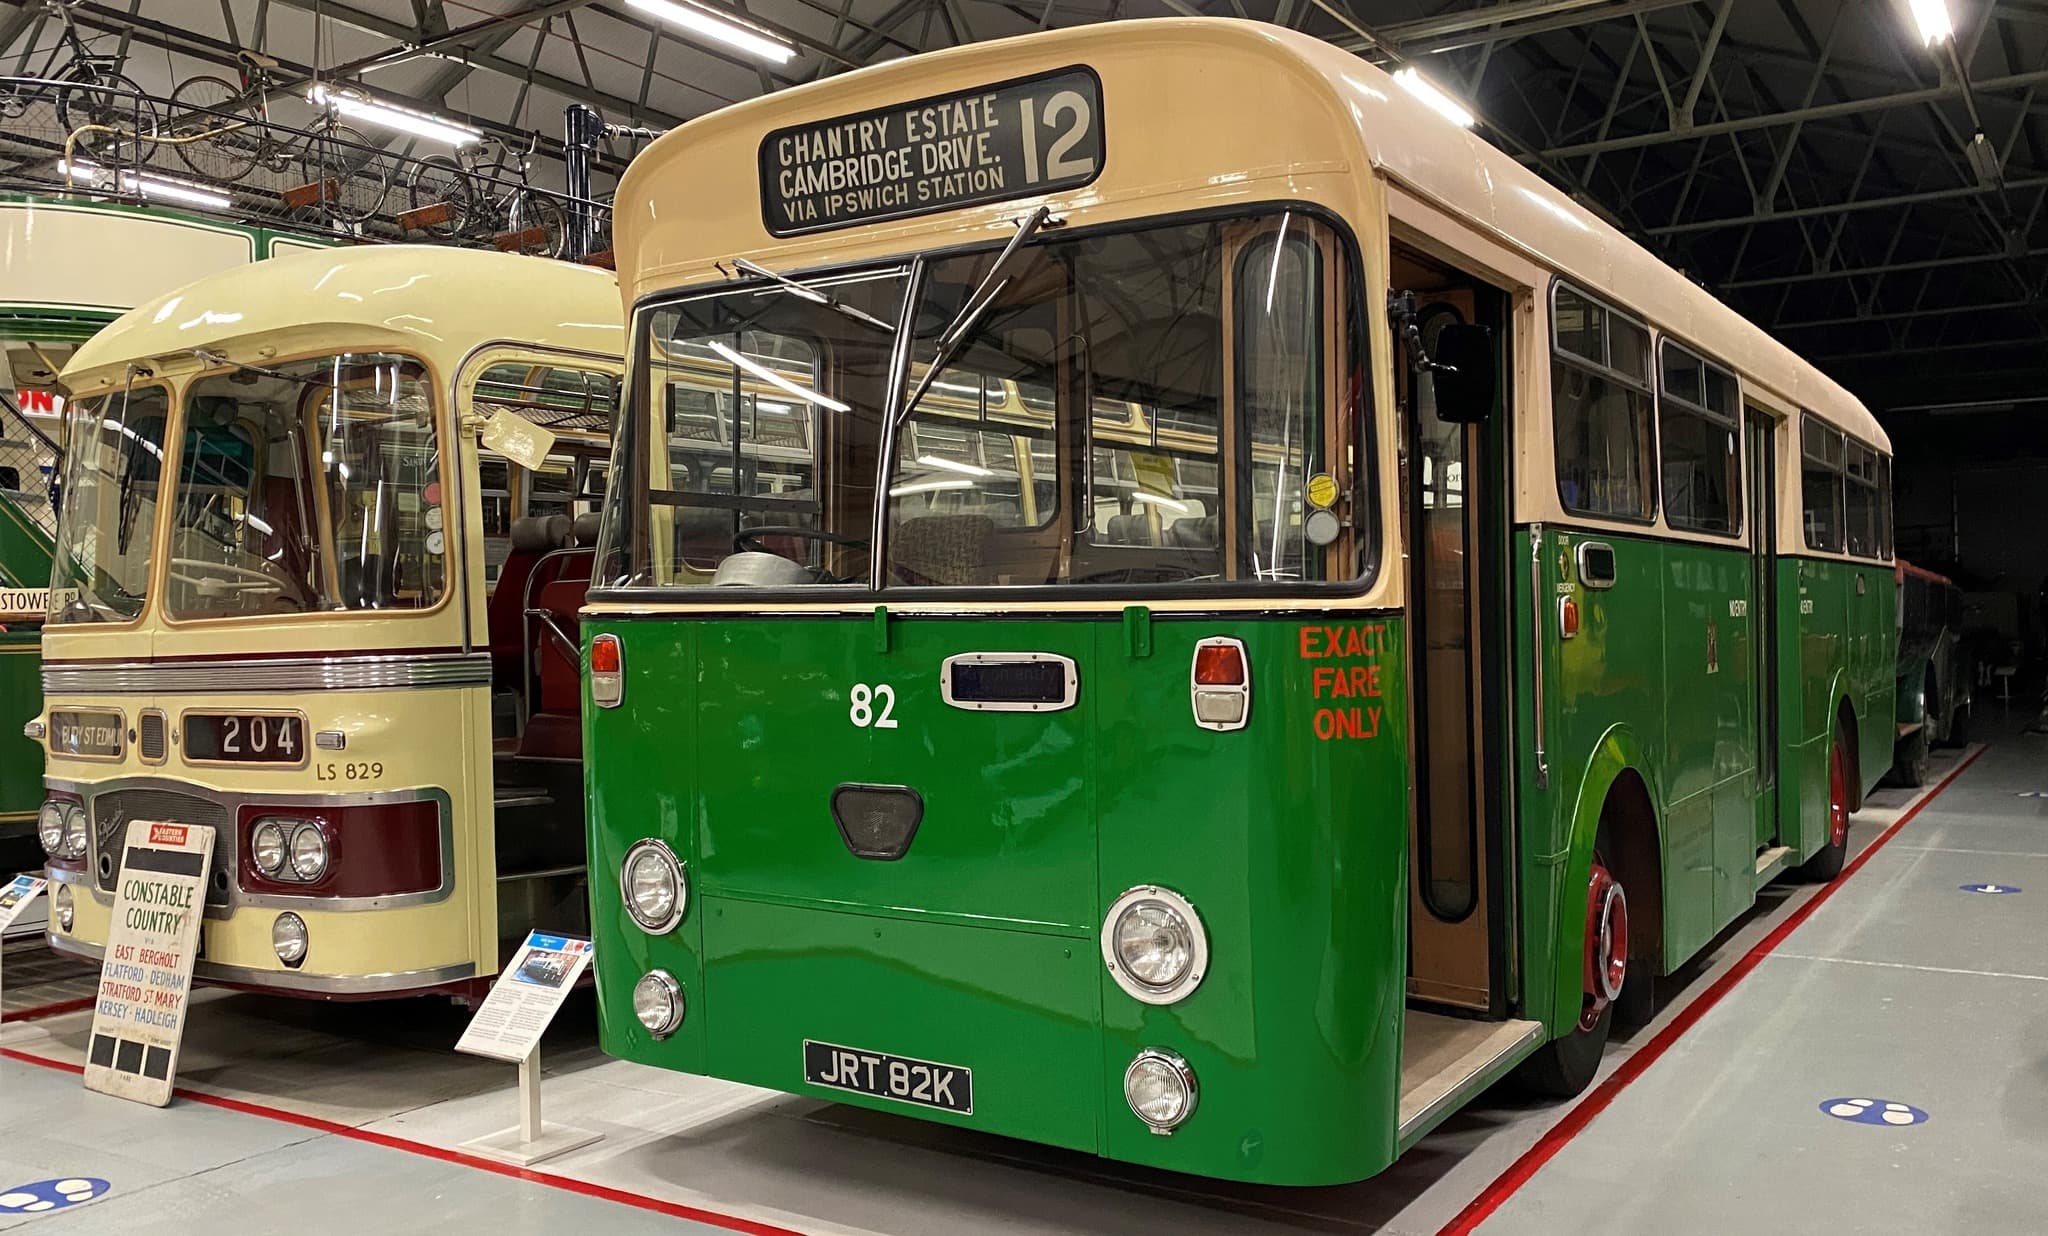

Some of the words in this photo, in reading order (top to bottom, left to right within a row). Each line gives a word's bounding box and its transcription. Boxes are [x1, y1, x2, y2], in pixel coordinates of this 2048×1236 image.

[778, 117, 889, 166] CHANTRY
[906, 94, 999, 142] ESTATE
[1019, 90, 1094, 184] 12
[780, 147, 914, 198] CAMBRIDGE
[922, 132, 1001, 173] DRIVE.
[783, 197, 817, 223] VIA
[825, 182, 909, 217] IPSWICH
[917, 166, 1004, 200] STATION
[1300, 624, 1385, 658] EXACT
[1313, 665, 1381, 699] FARE
[850, 683, 898, 728] 82
[223, 716, 294, 754] 204
[1313, 706, 1381, 740] ONLY
[317, 763, 336, 781] LS
[346, 762, 383, 780] 829
[124, 880, 194, 909] CONSTABLE
[126, 907, 183, 936] COUNTRY
[115, 944, 135, 960] EAST
[139, 948, 180, 968] BERGHOLT
[104, 962, 144, 982] FLATFORD
[150, 970, 185, 990] DEDHAM
[101, 981, 141, 1001] STRATFORD
[155, 991, 182, 1009] MARY
[98, 1000, 128, 1020] KERSEY
[134, 1007, 178, 1030] HADLEIGH
[820, 1050, 880, 1090] JRT
[889, 1061, 955, 1106] 82K
